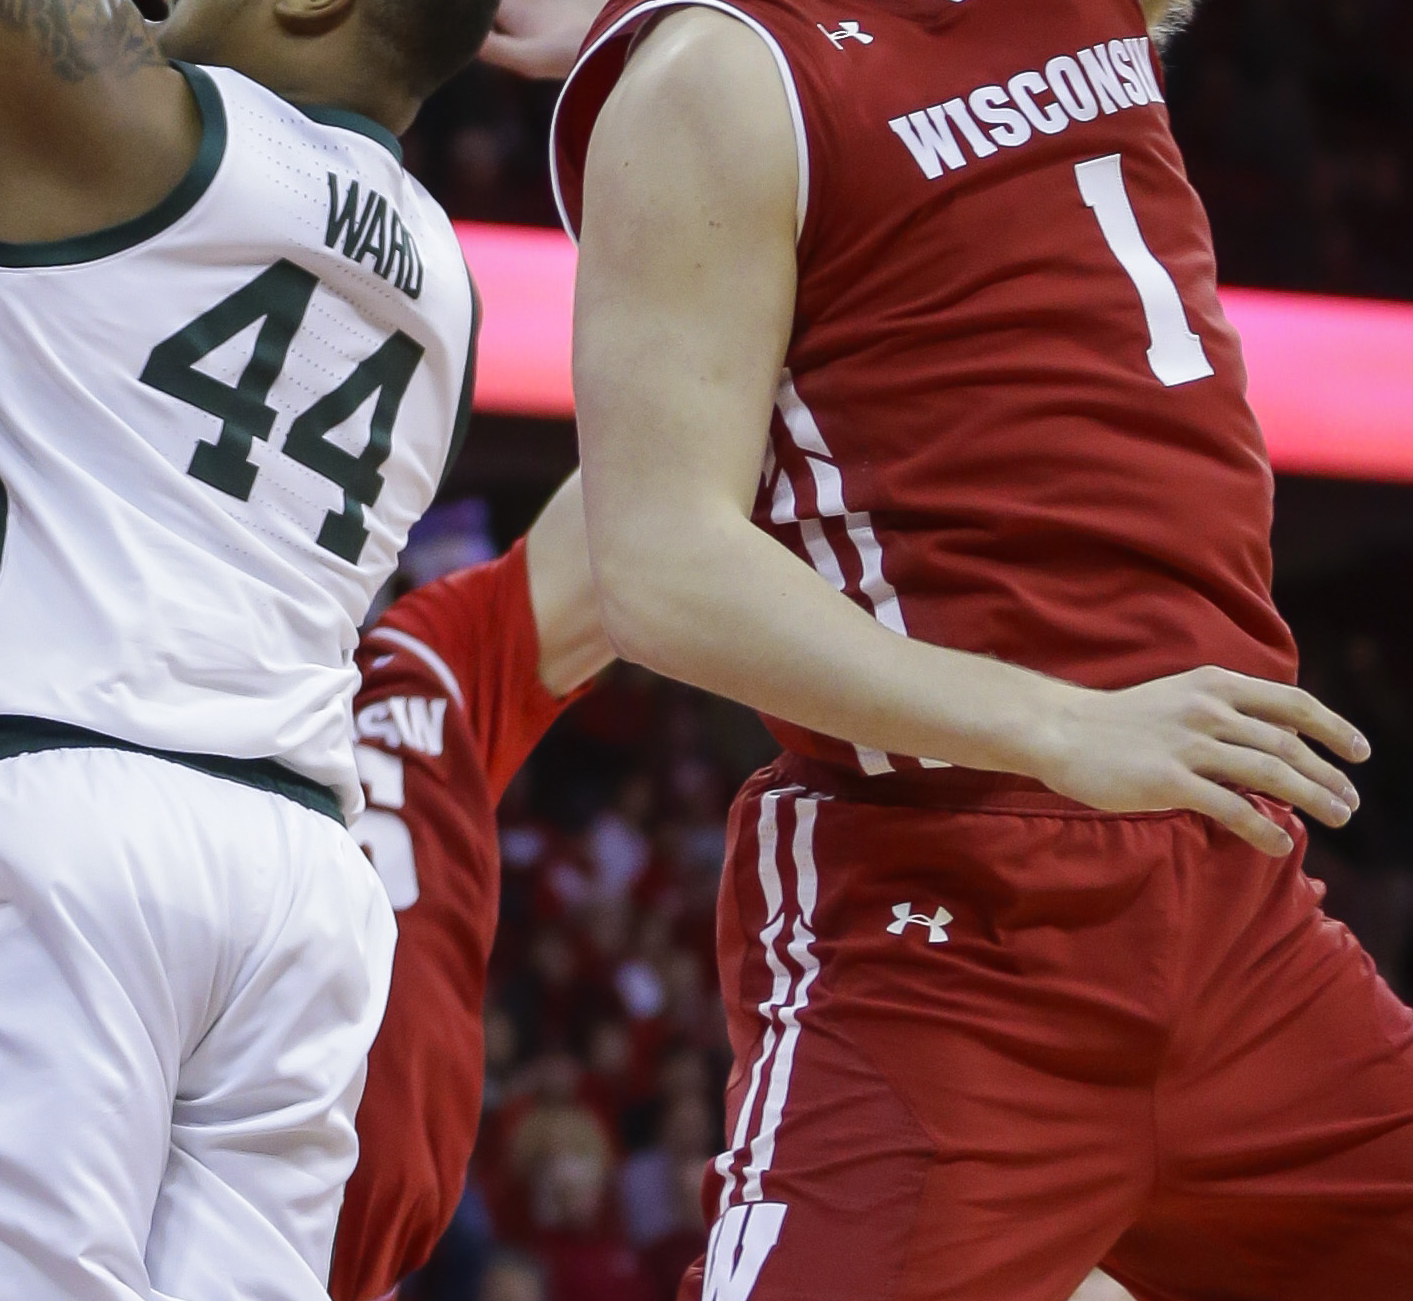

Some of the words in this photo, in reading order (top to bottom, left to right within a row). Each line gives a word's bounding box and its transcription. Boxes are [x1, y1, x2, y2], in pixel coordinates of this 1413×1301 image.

[325, 171, 424, 300] WARD
[1073, 153, 1215, 388] 1
[139, 257, 425, 566] 44
